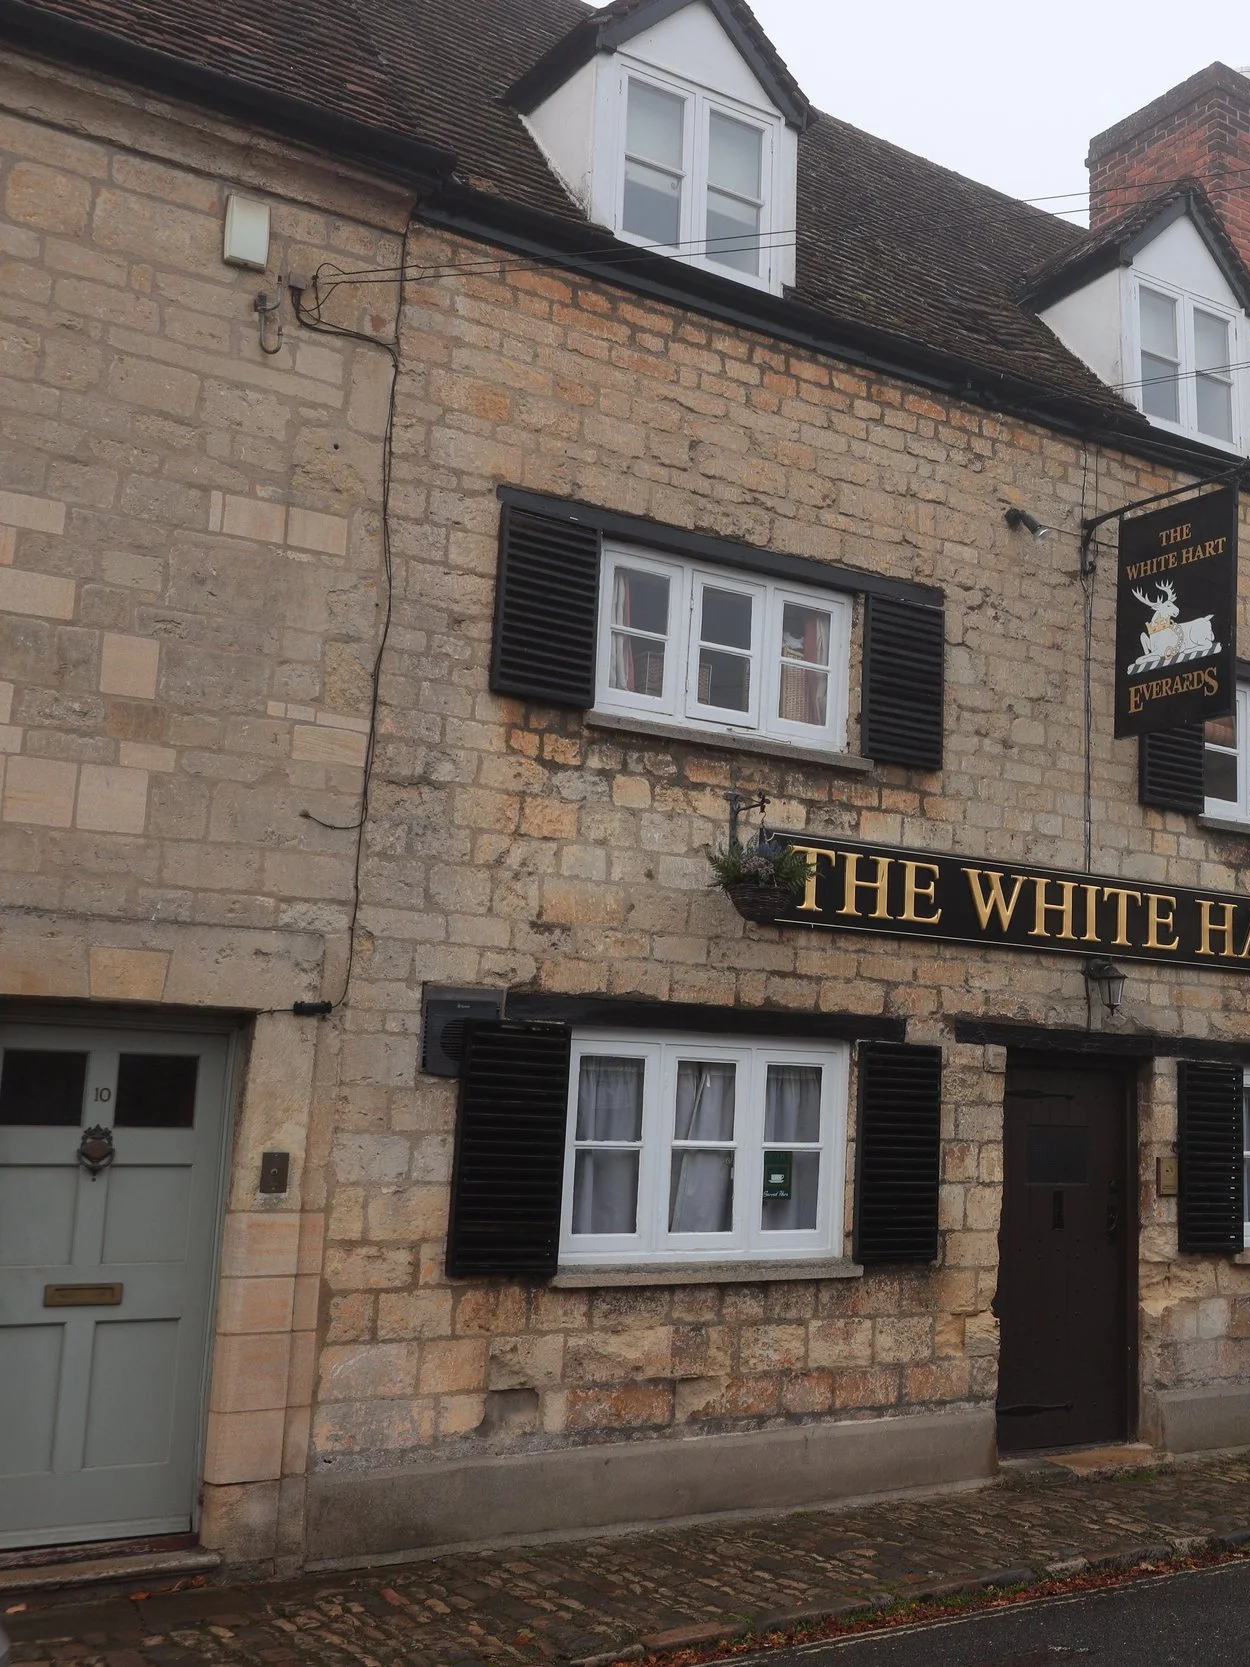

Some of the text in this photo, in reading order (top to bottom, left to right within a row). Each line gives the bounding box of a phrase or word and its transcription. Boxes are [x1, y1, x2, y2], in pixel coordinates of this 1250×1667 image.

[1159, 523, 1192, 546] THE
[1126, 537, 1227, 581] WHITE HART
[1128, 666, 1219, 714] EVERARDS
[788, 845, 943, 925] THE
[960, 867, 1180, 951] WHITE
[94, 1087, 111, 1102] 10
